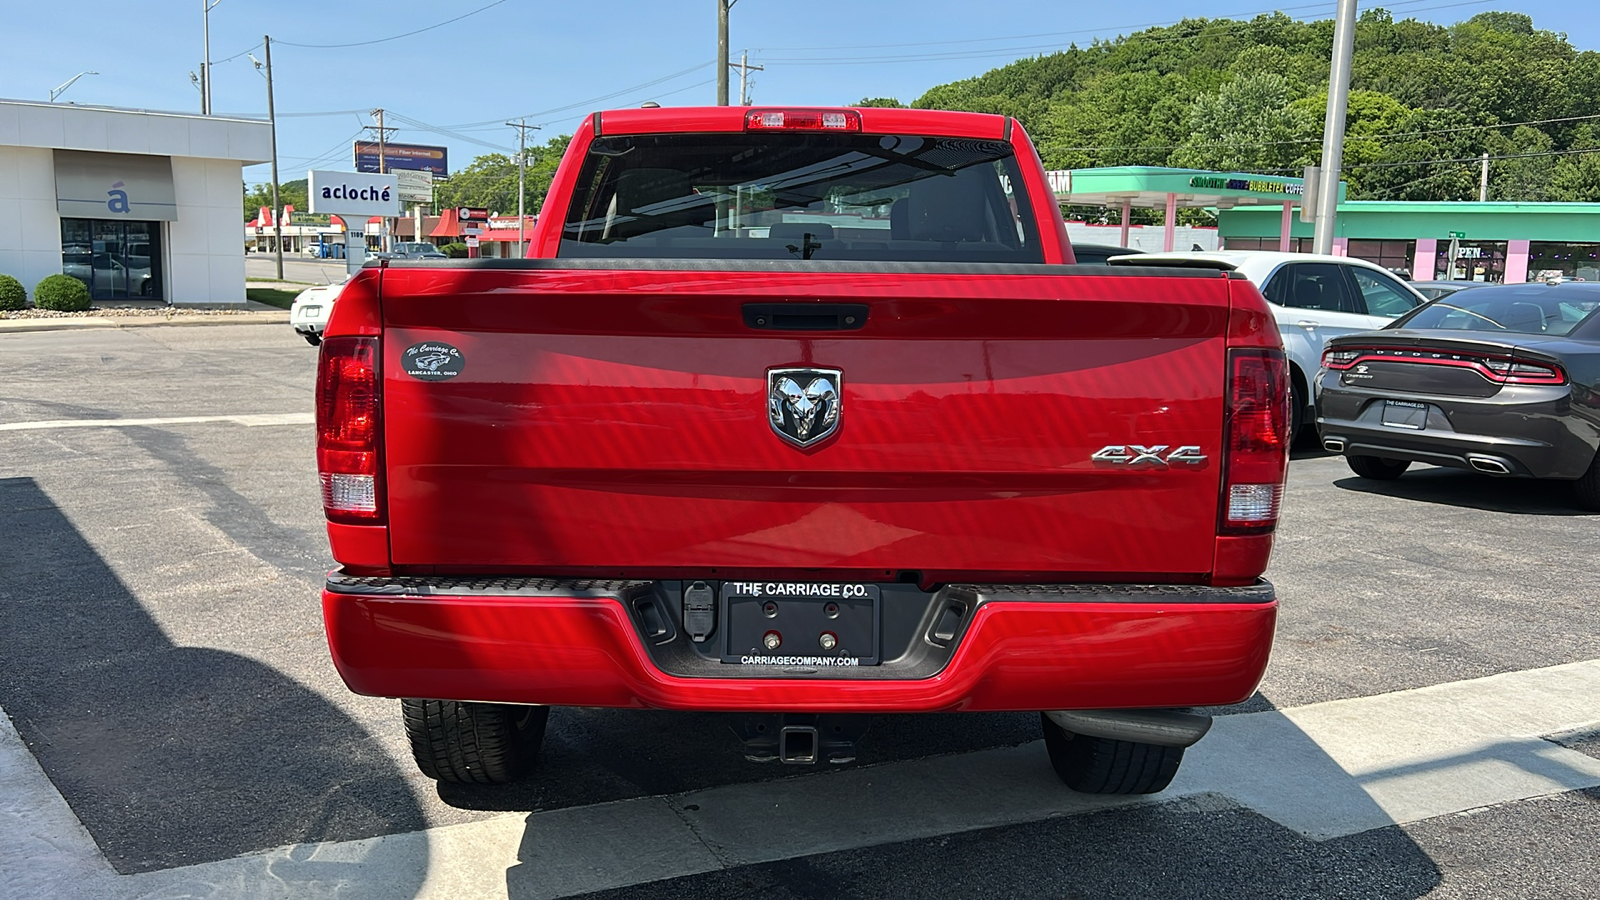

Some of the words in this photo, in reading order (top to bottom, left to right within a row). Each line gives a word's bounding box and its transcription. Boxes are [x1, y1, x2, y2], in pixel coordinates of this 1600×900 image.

[322, 184, 391, 202] acloché
[1249, 180, 1284, 193] BUBBLETEA
[1285, 183, 1304, 195] COFFE
[1457, 247, 1481, 258] PEN
[406, 347, 418, 356] The
[419, 344, 449, 355] Carriage
[1376, 349, 1461, 360] DODGE
[1395, 400, 1417, 408] CARRIAGE
[734, 582, 763, 596] THE
[766, 583, 840, 596] CARRIAGE
[845, 584, 868, 597] CO.
[741, 655, 859, 667] CARRIAGECOMPANY.COM
